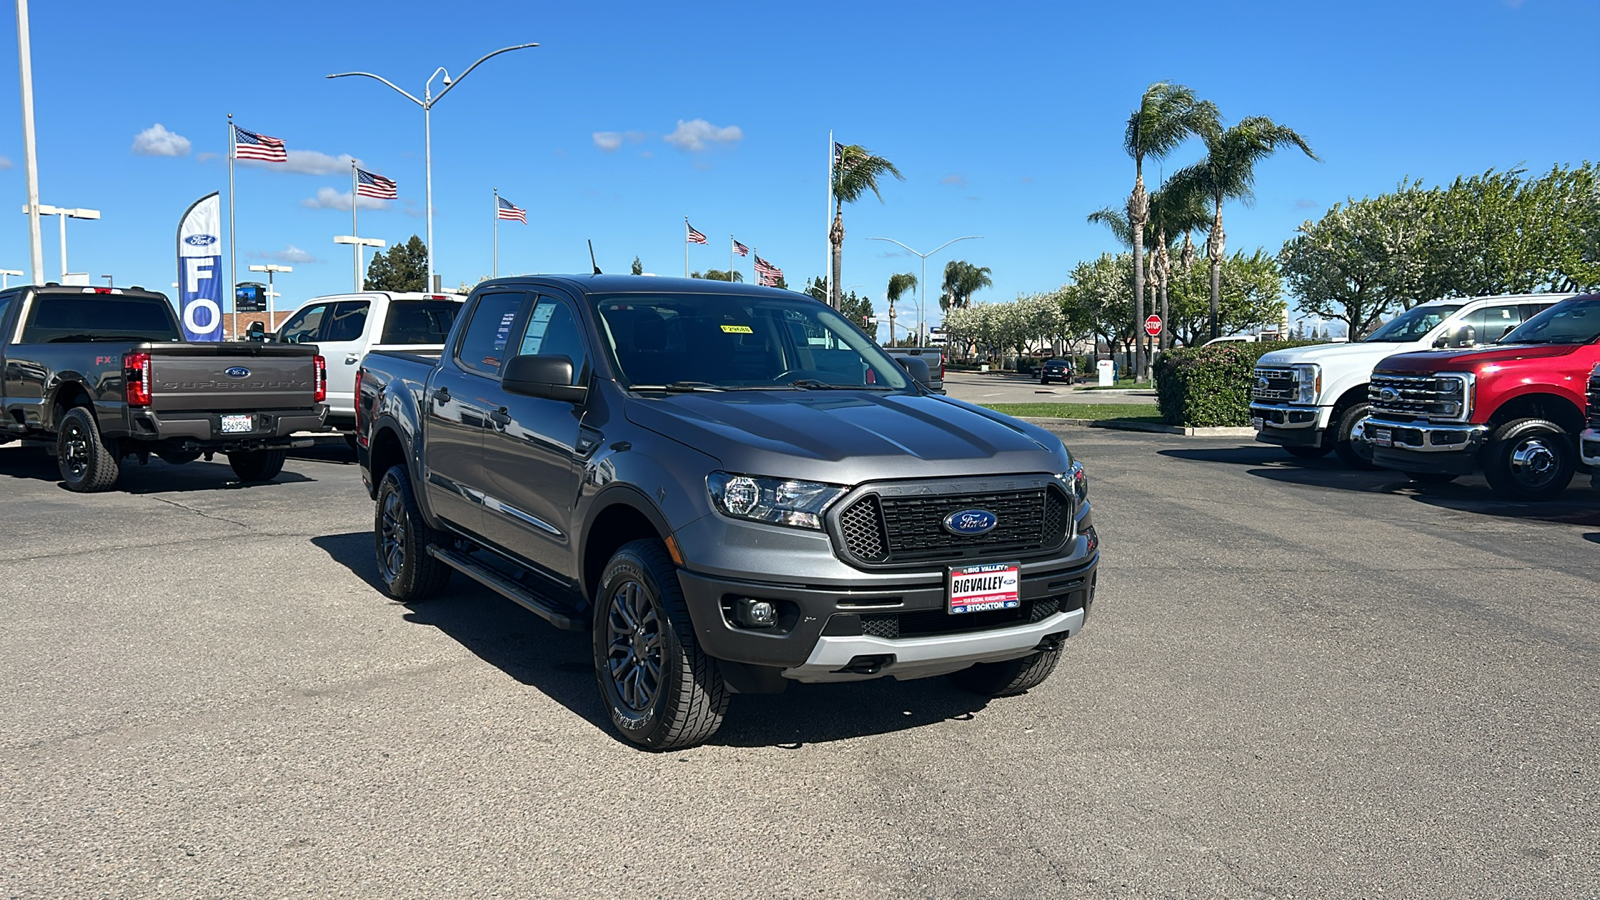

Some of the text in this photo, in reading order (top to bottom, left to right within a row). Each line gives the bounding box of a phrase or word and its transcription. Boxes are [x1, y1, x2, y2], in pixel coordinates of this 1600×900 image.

[1147, 321, 1161, 329] STOP
[95, 356, 118, 366] FX4
[162, 380, 308, 390] SUPER DUTY
[960, 514, 988, 529] Ford
[981, 564, 1005, 572] VALLEY
[953, 576, 1004, 593] BIGVALLEY
[967, 602, 1004, 611] STOCKTON
